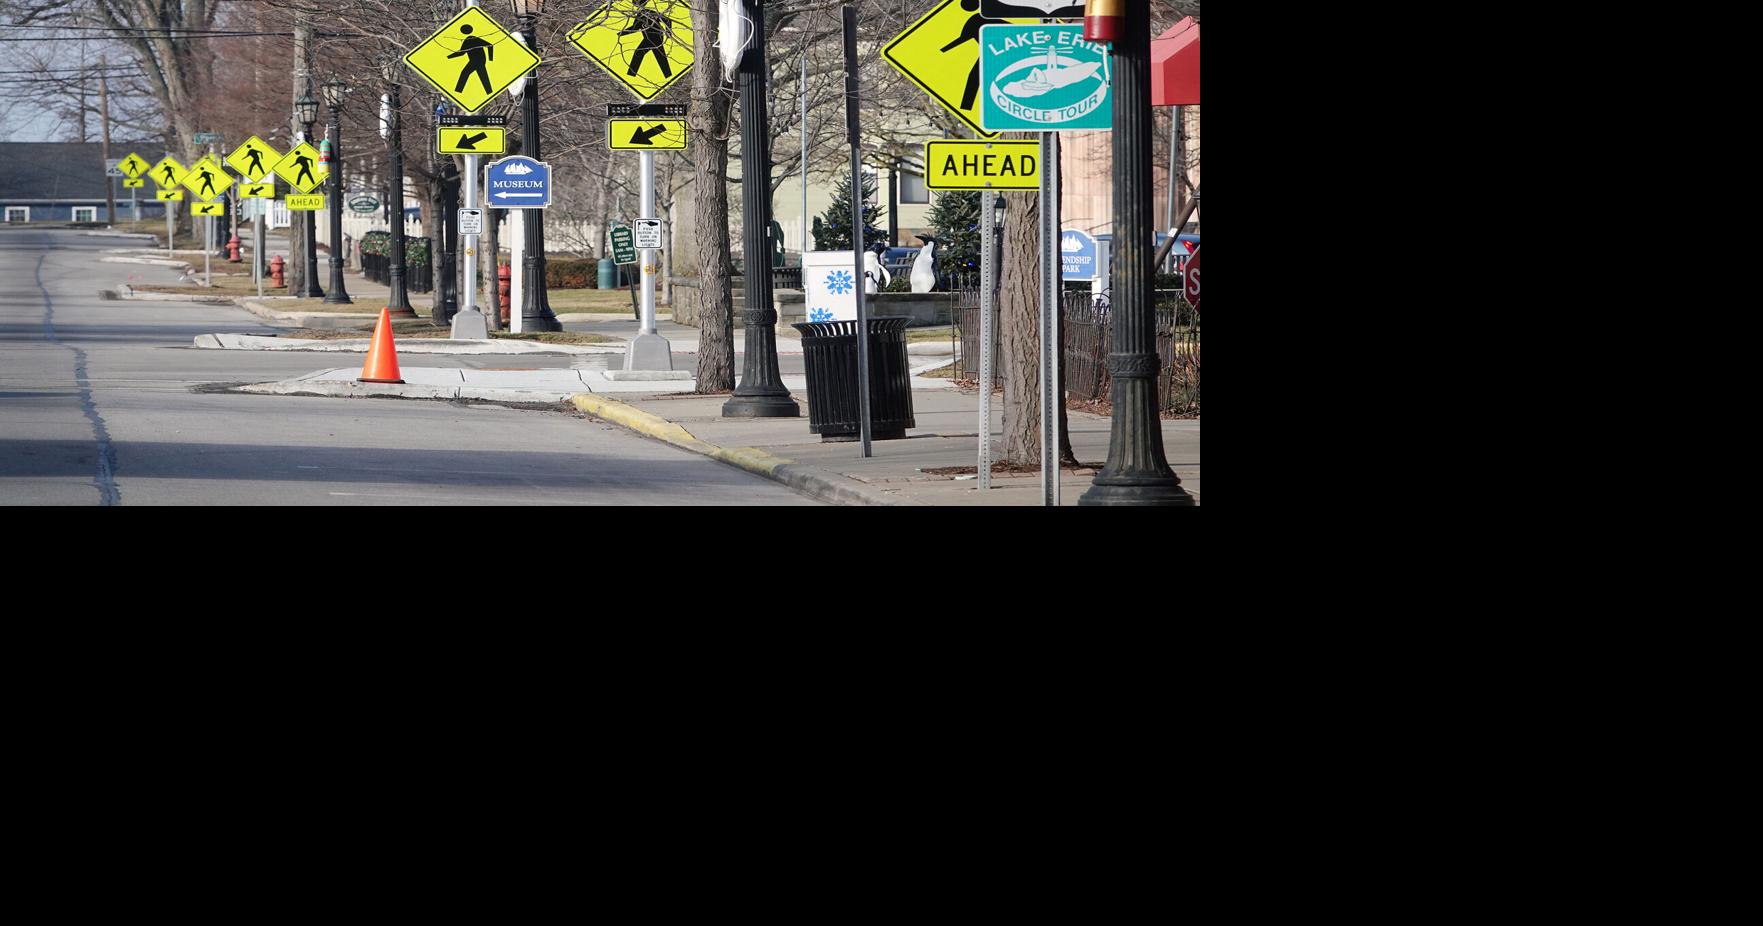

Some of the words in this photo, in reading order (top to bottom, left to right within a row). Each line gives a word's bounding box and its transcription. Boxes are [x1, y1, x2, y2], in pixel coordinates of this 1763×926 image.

[988, 30, 1045, 56] LAKE
[996, 94, 1051, 121] CIRCLE
[1059, 94, 1098, 119] TOUR
[942, 154, 1036, 177] AHEAD
[493, 180, 543, 188] MUSEUM
[290, 198, 320, 206] AHEAD
[1062, 264, 1081, 273] PARK
